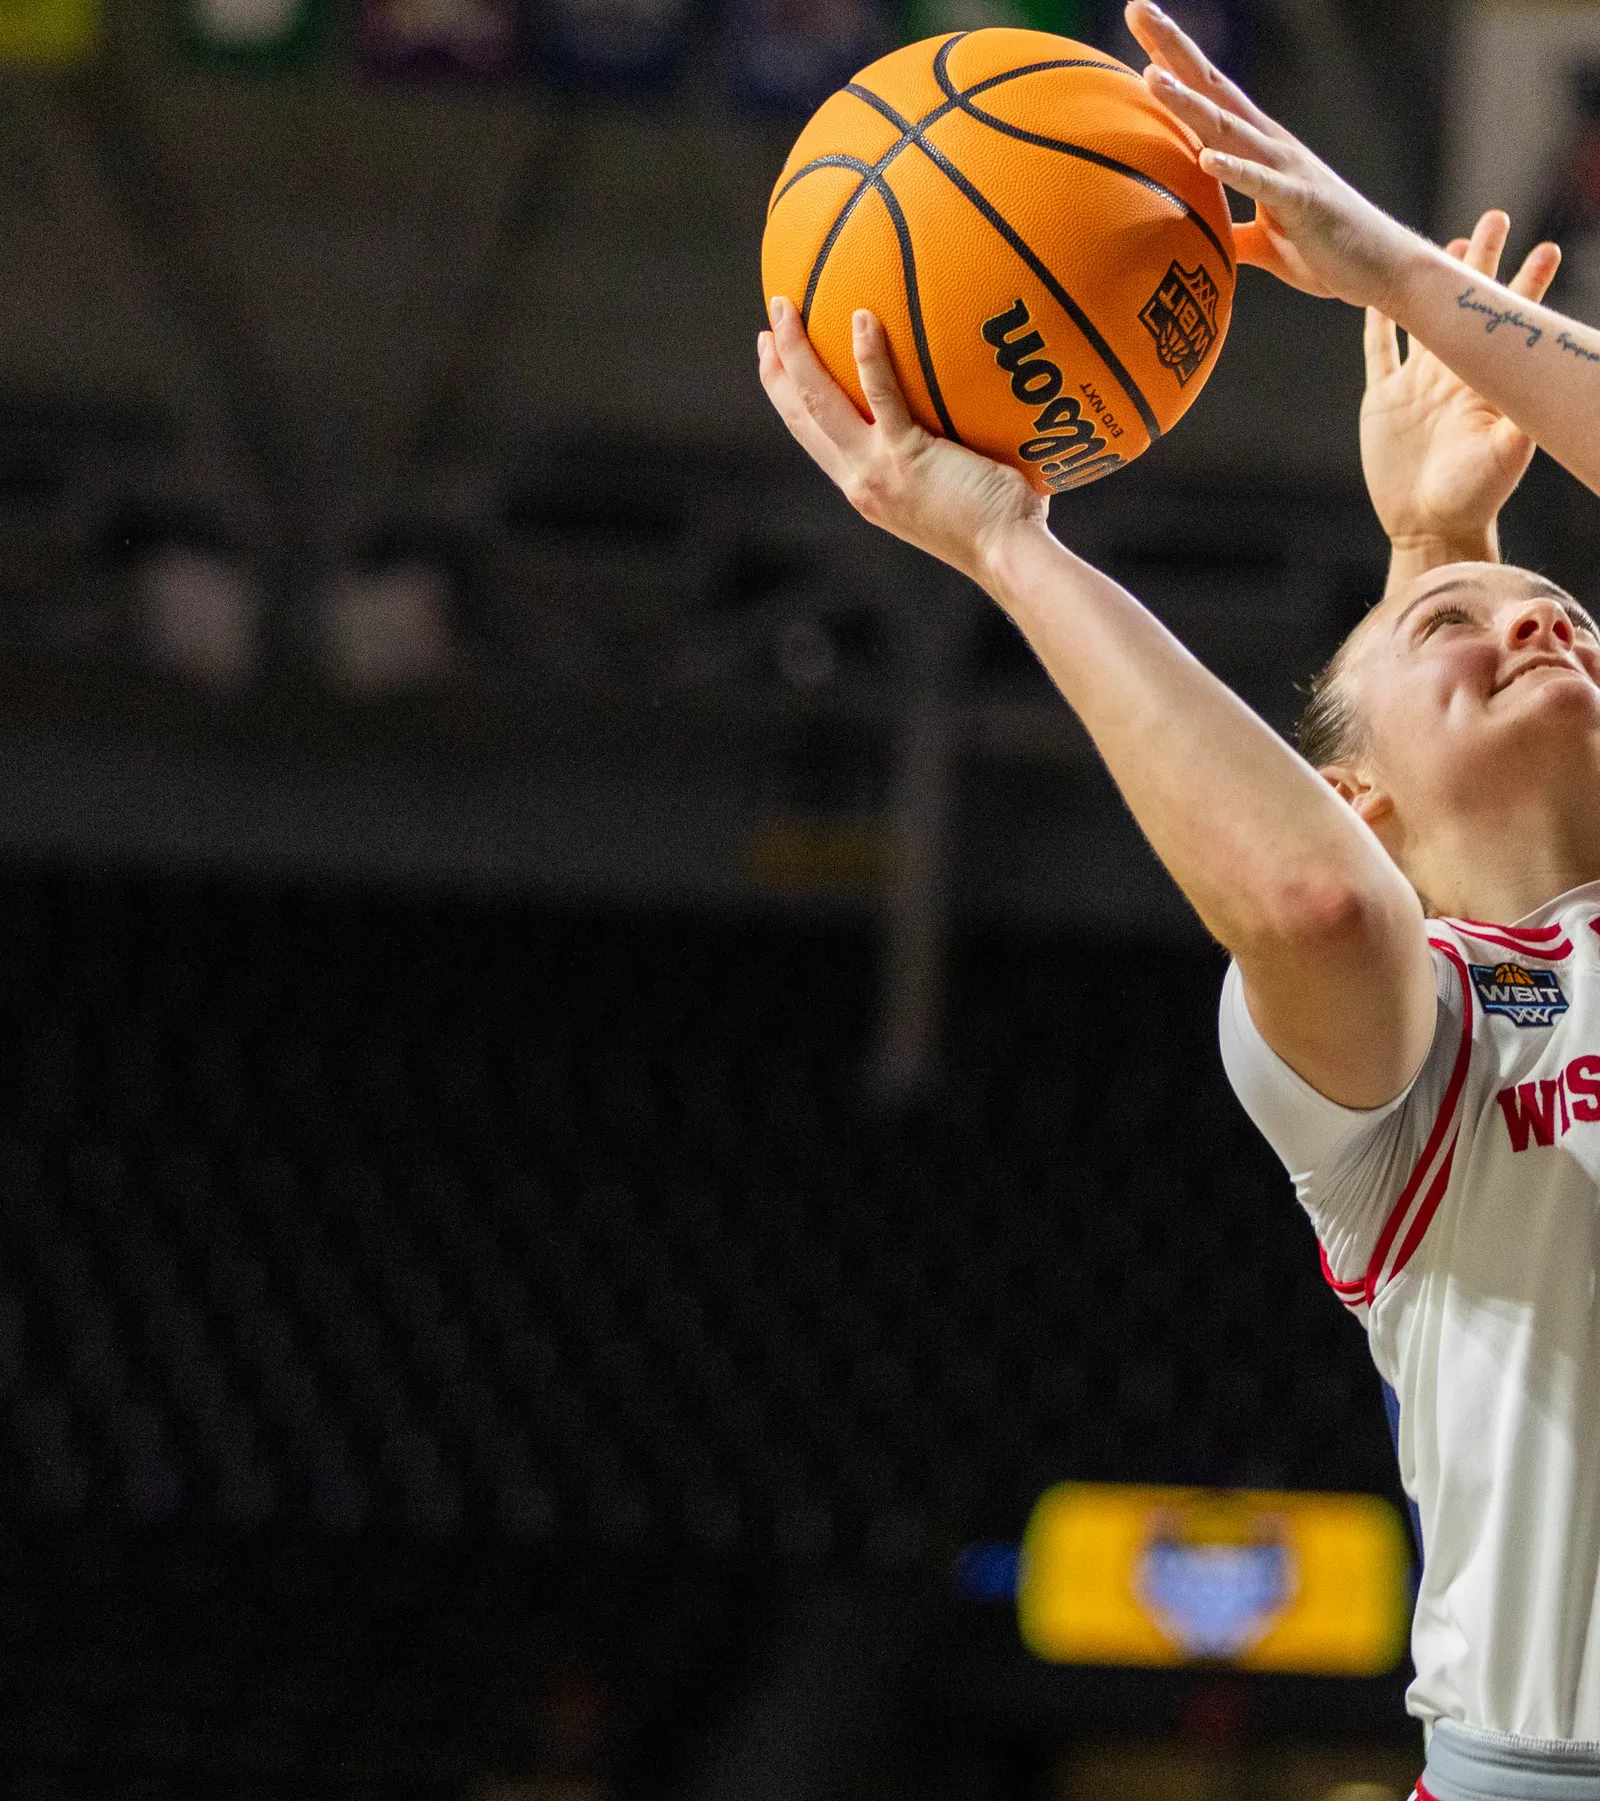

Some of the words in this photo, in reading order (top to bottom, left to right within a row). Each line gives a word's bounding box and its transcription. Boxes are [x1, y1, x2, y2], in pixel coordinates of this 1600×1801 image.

[1158, 283, 1210, 361] WBIT
[981, 298, 1128, 493] Wilson
[1079, 381, 1106, 414] NXT
[1101, 412, 1125, 440] EVO
[1478, 983, 1560, 1005] WBIT
